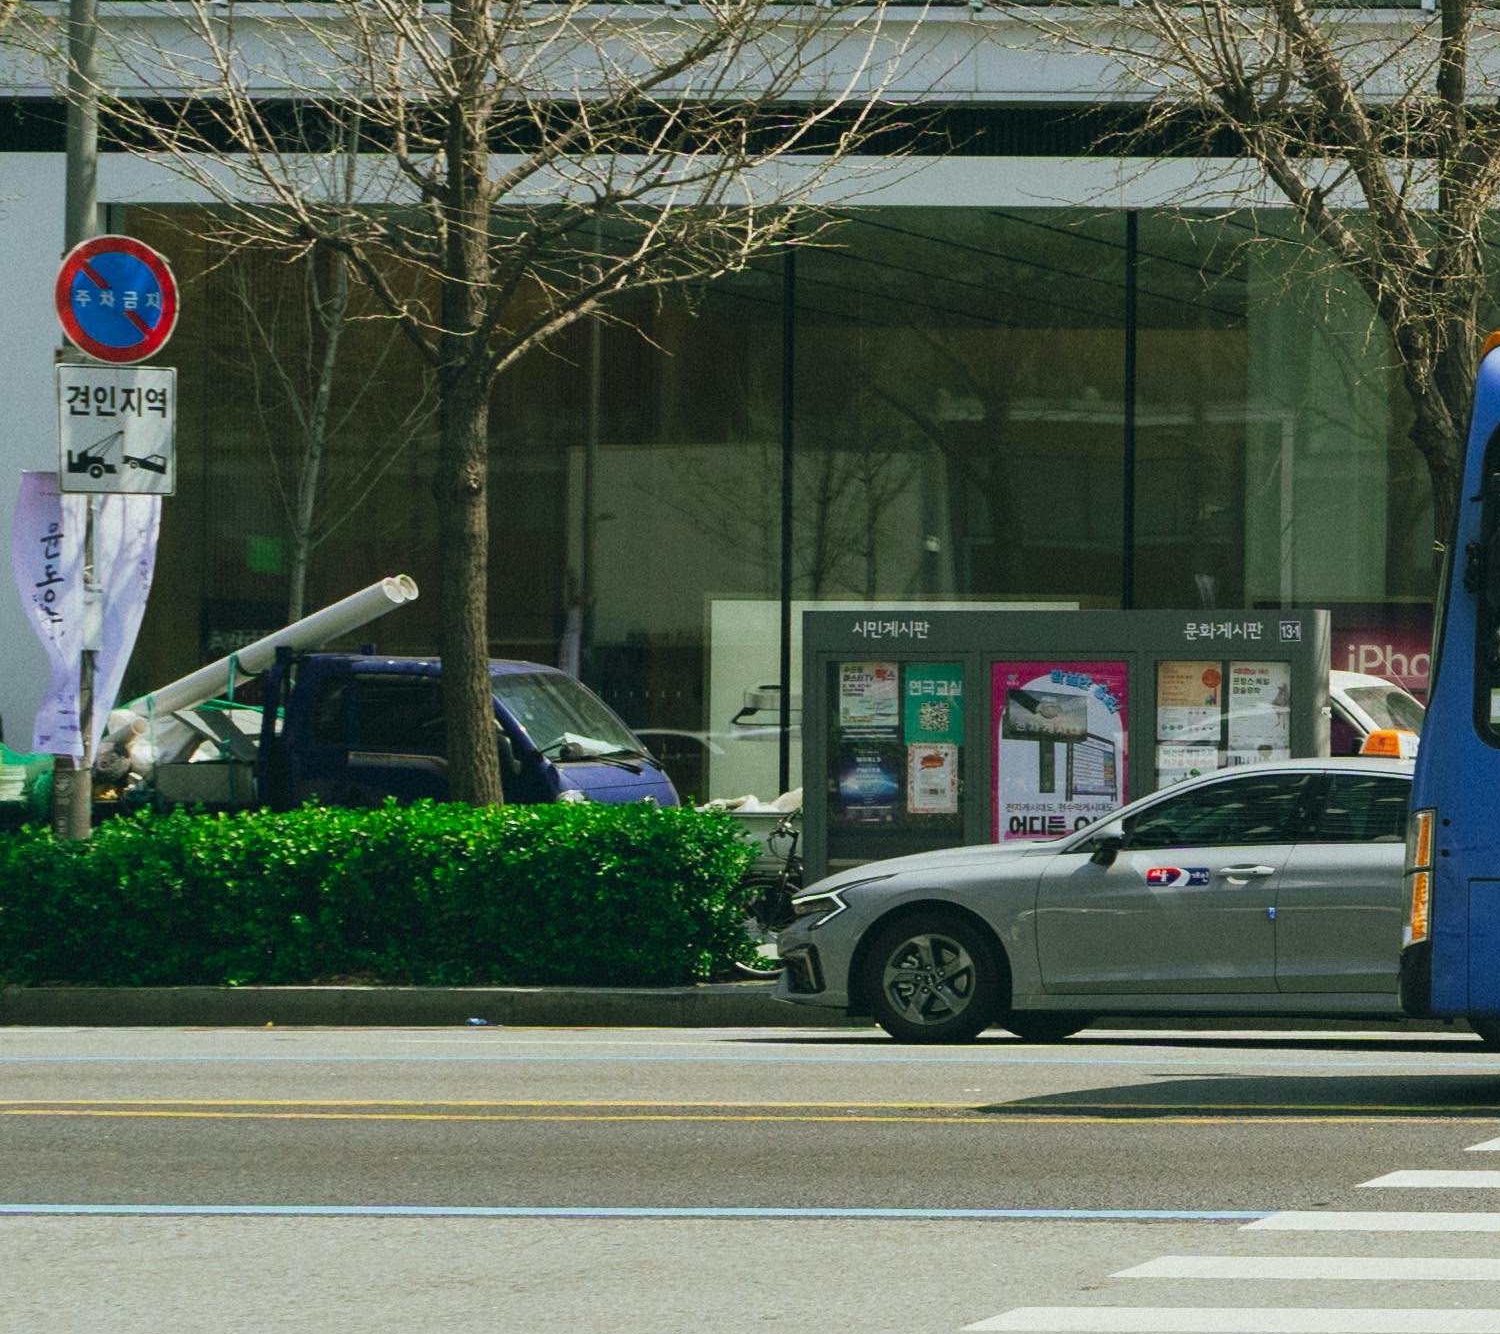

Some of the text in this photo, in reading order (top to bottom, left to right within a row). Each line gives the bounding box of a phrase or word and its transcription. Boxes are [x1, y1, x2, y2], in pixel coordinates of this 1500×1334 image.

[75, 289, 161, 309] 주차금지
[66, 385, 168, 418] 견인지역
[852, 620, 931, 639] 시민게시판
[1183, 621, 1264, 641] 문화게시판
[1347, 644, 1431, 676] iPho
[1009, 815, 1067, 836] 어디든
